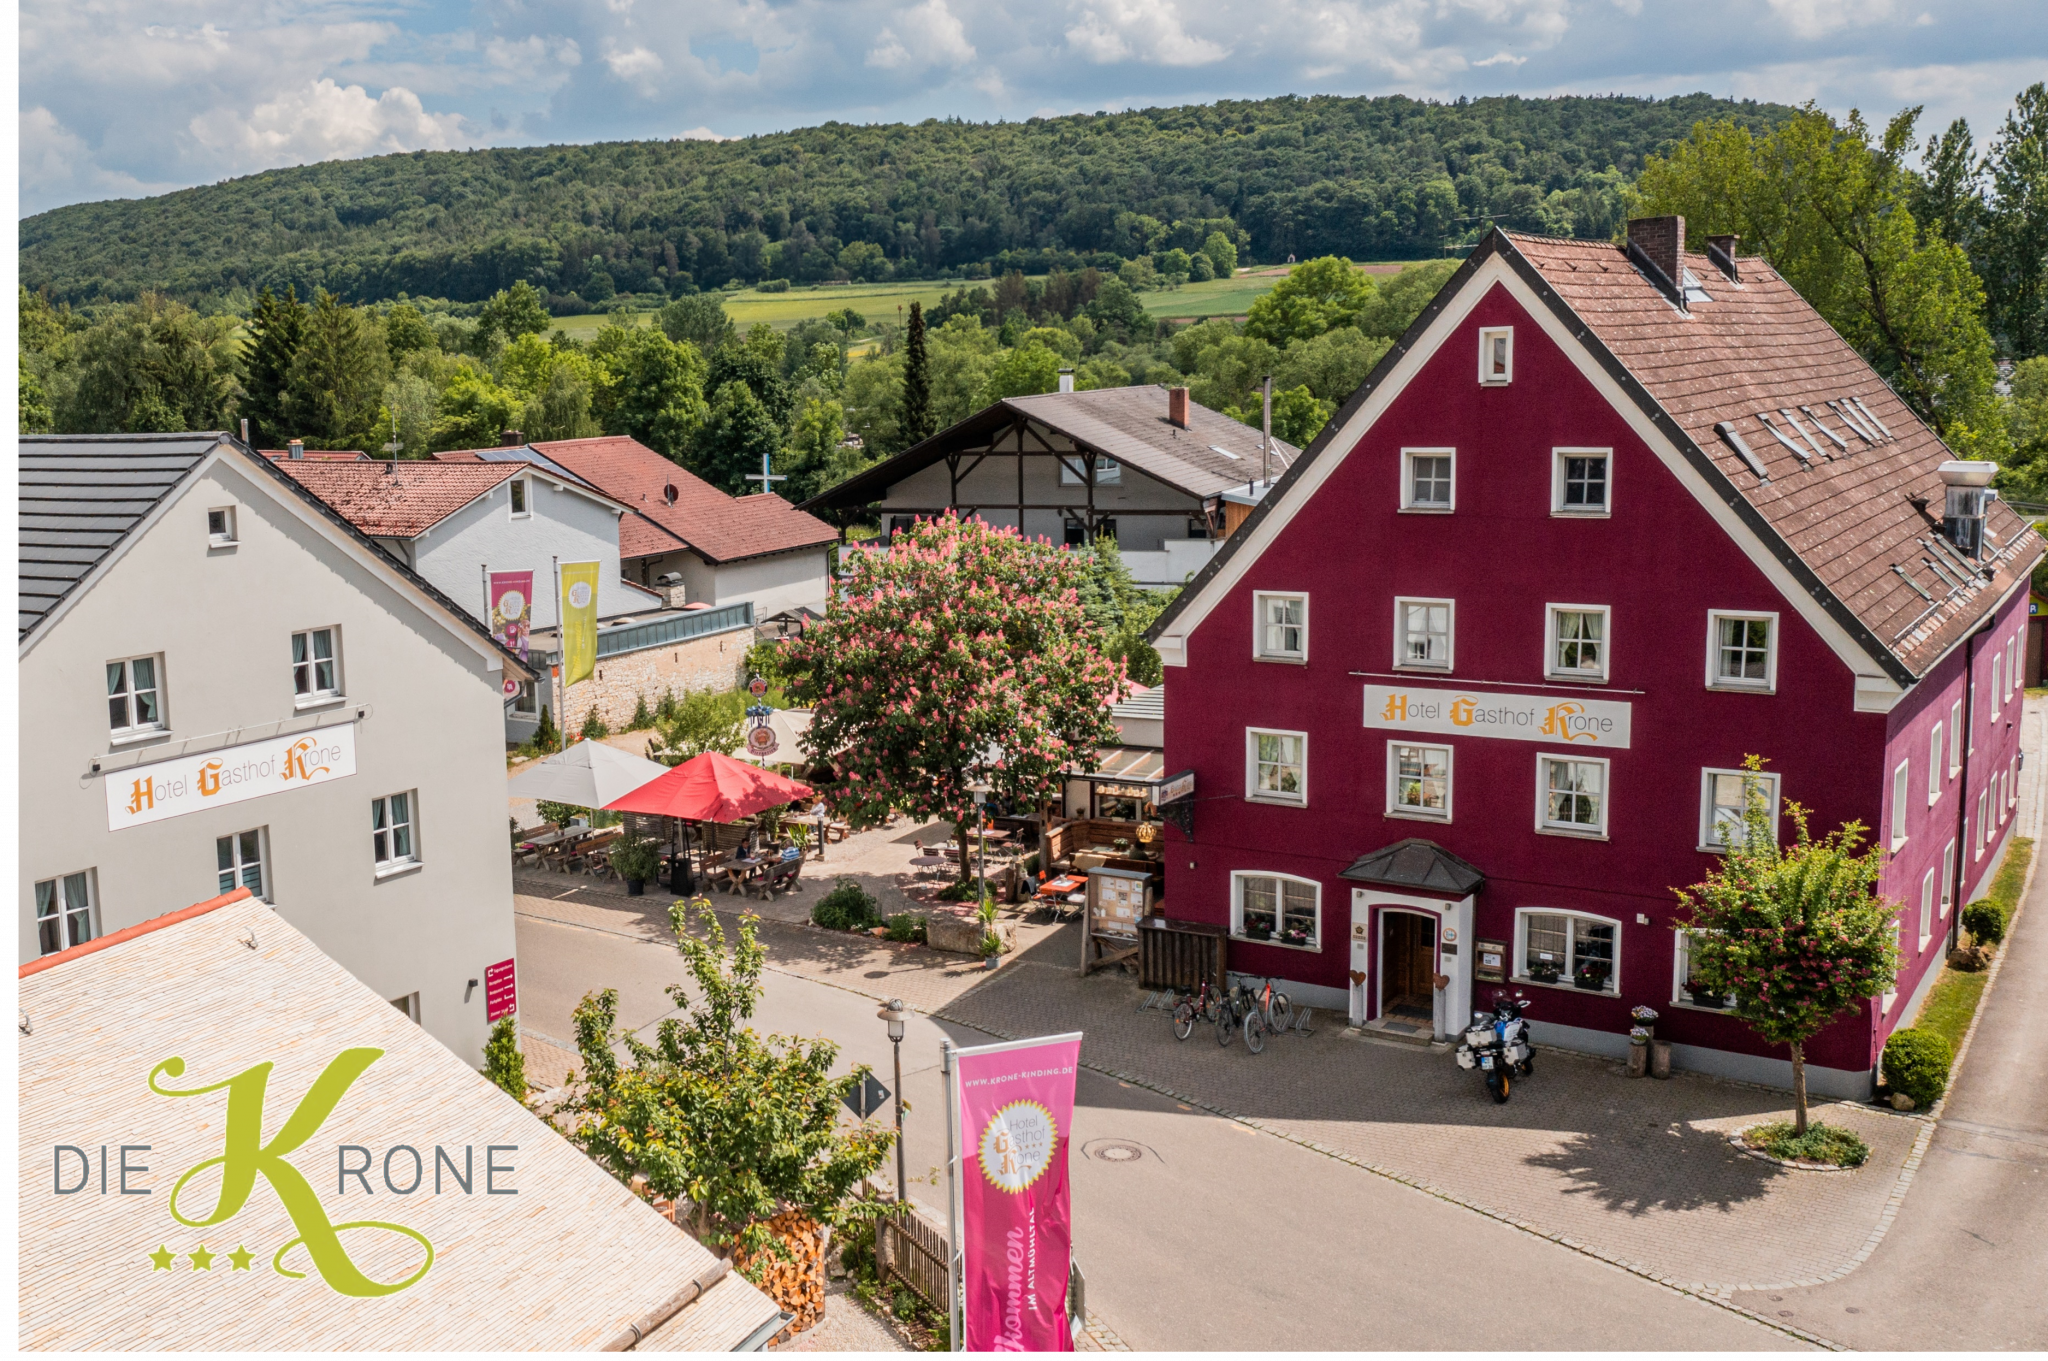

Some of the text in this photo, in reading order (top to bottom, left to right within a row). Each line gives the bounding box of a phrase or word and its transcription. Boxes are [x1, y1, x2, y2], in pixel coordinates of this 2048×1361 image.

[1379, 693, 1613, 742] Hotel Gasthof Krone
[125, 736, 341, 815] Hotel Gasthof Krone
[965, 1066, 1074, 1088] WWW.KRONE-KINDING.DE
[993, 1126, 1046, 1154] Gasthof
[1009, 1115, 1039, 1131] Hotel
[1027, 1207, 1037, 1310] IM ALTMÜHLTAL
